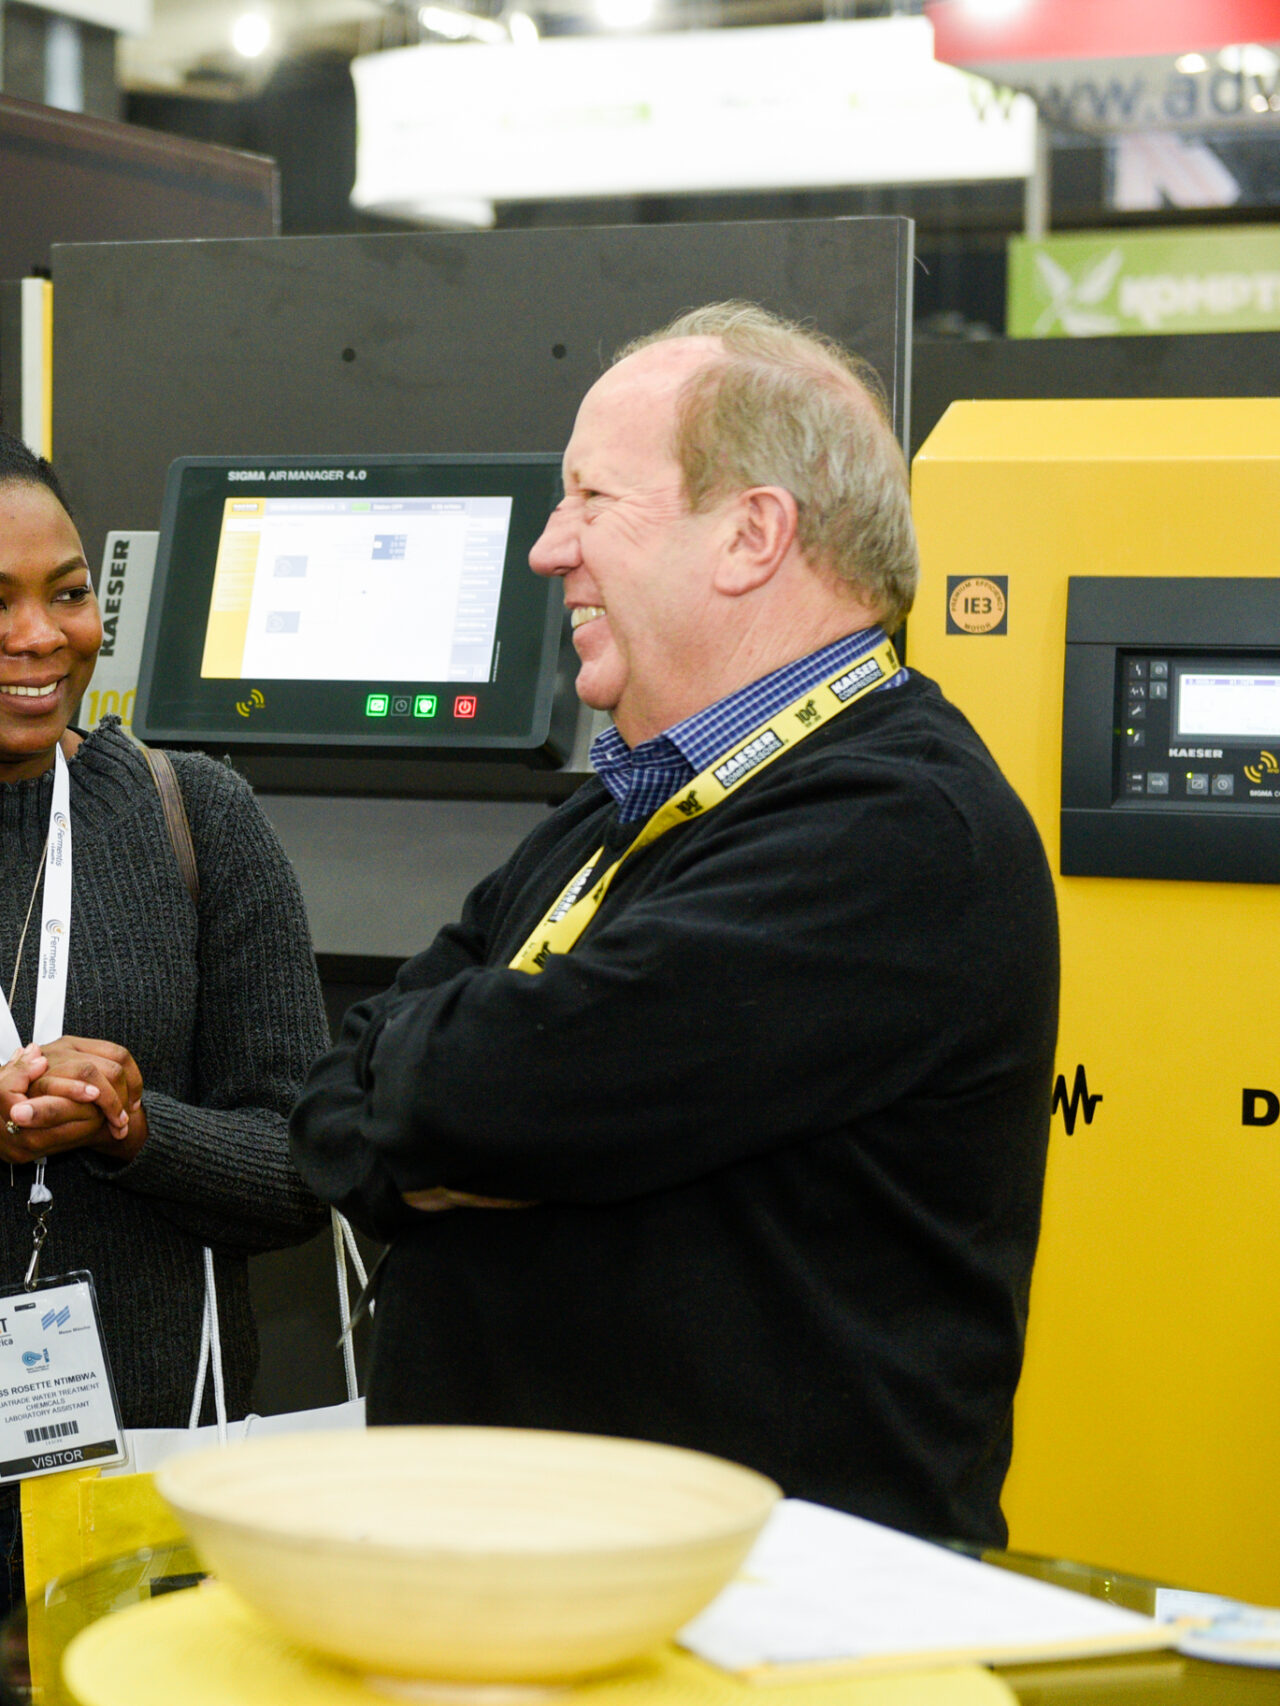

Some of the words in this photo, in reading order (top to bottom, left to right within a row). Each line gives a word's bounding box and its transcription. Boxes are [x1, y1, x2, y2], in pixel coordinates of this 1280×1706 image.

[227, 470, 266, 481] SIGMA
[268, 470, 287, 481] AIR
[288, 470, 344, 481] MANAGER
[346, 470, 367, 481] 4.0
[99, 539, 130, 657] KAESER
[964, 597, 992, 614] IE3
[964, 622, 991, 632] MOTOR
[829, 659, 879, 695] KAESER
[714, 731, 777, 781] KAESER
[1168, 748, 1223, 758] KAESER
[722, 740, 783, 787] COMPRESSORS
[1249, 789, 1273, 797] SIGMA
[47, 936, 60, 980] Fermentis
[11, 1380, 52, 1395] ROSETTE
[54, 1371, 96, 1387] NTIMBWA
[32, 1390, 57, 1402] WATER
[58, 1382, 100, 1396] TREATMENT
[5, 1409, 51, 1423] LABORATORY
[52, 1400, 90, 1414] ASSISTANT
[25, 1397, 66, 1411] CHEMICALS
[31, 1449, 84, 1469] VISITOR
